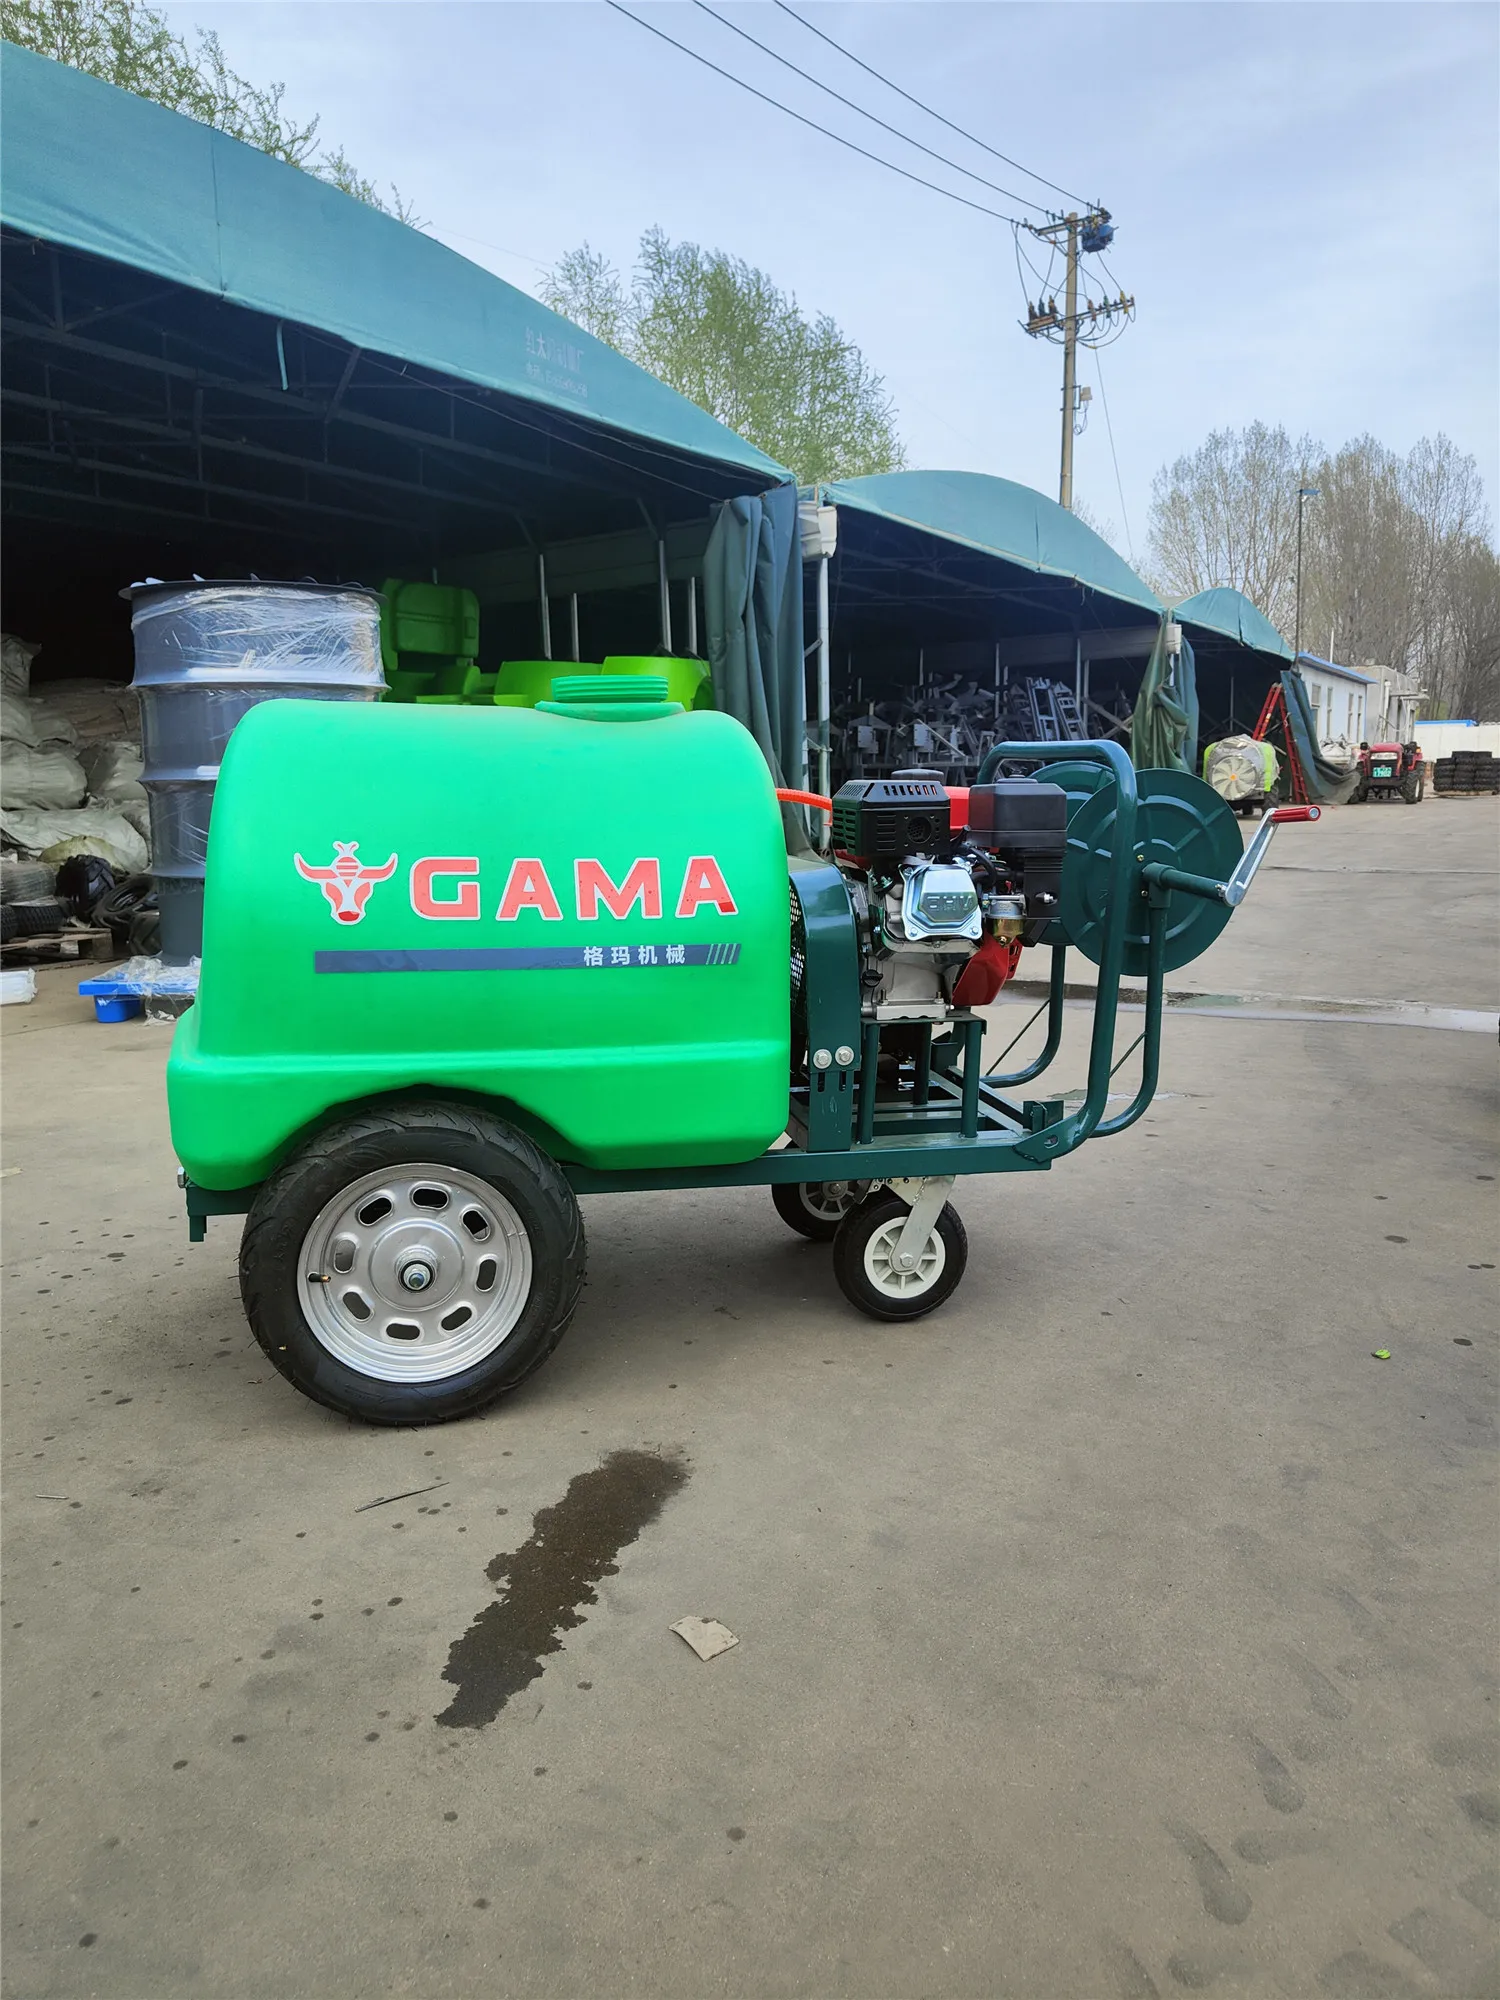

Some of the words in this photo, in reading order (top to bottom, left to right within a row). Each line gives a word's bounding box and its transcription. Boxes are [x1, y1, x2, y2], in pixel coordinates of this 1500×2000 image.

[409, 855, 739, 921] GAMA
[583, 944, 685, 966] 格玛机械
